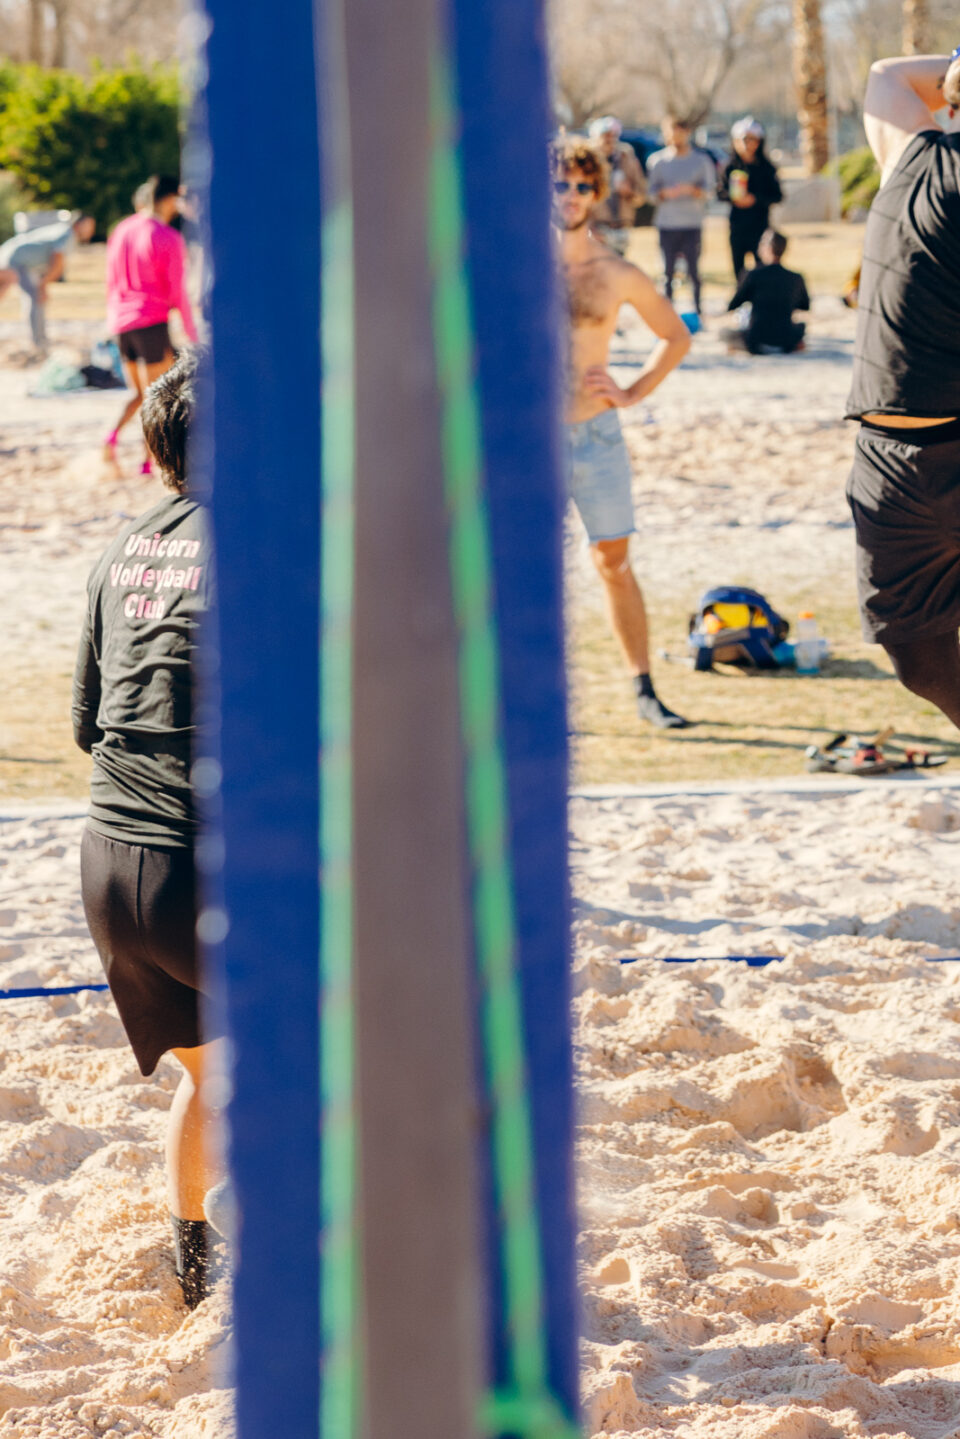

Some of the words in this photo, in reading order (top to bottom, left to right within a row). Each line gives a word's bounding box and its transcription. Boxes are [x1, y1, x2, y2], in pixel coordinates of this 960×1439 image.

[124, 532, 201, 558] Unicorn
[110, 563, 203, 593] Volleyball
[124, 593, 166, 619] Club
